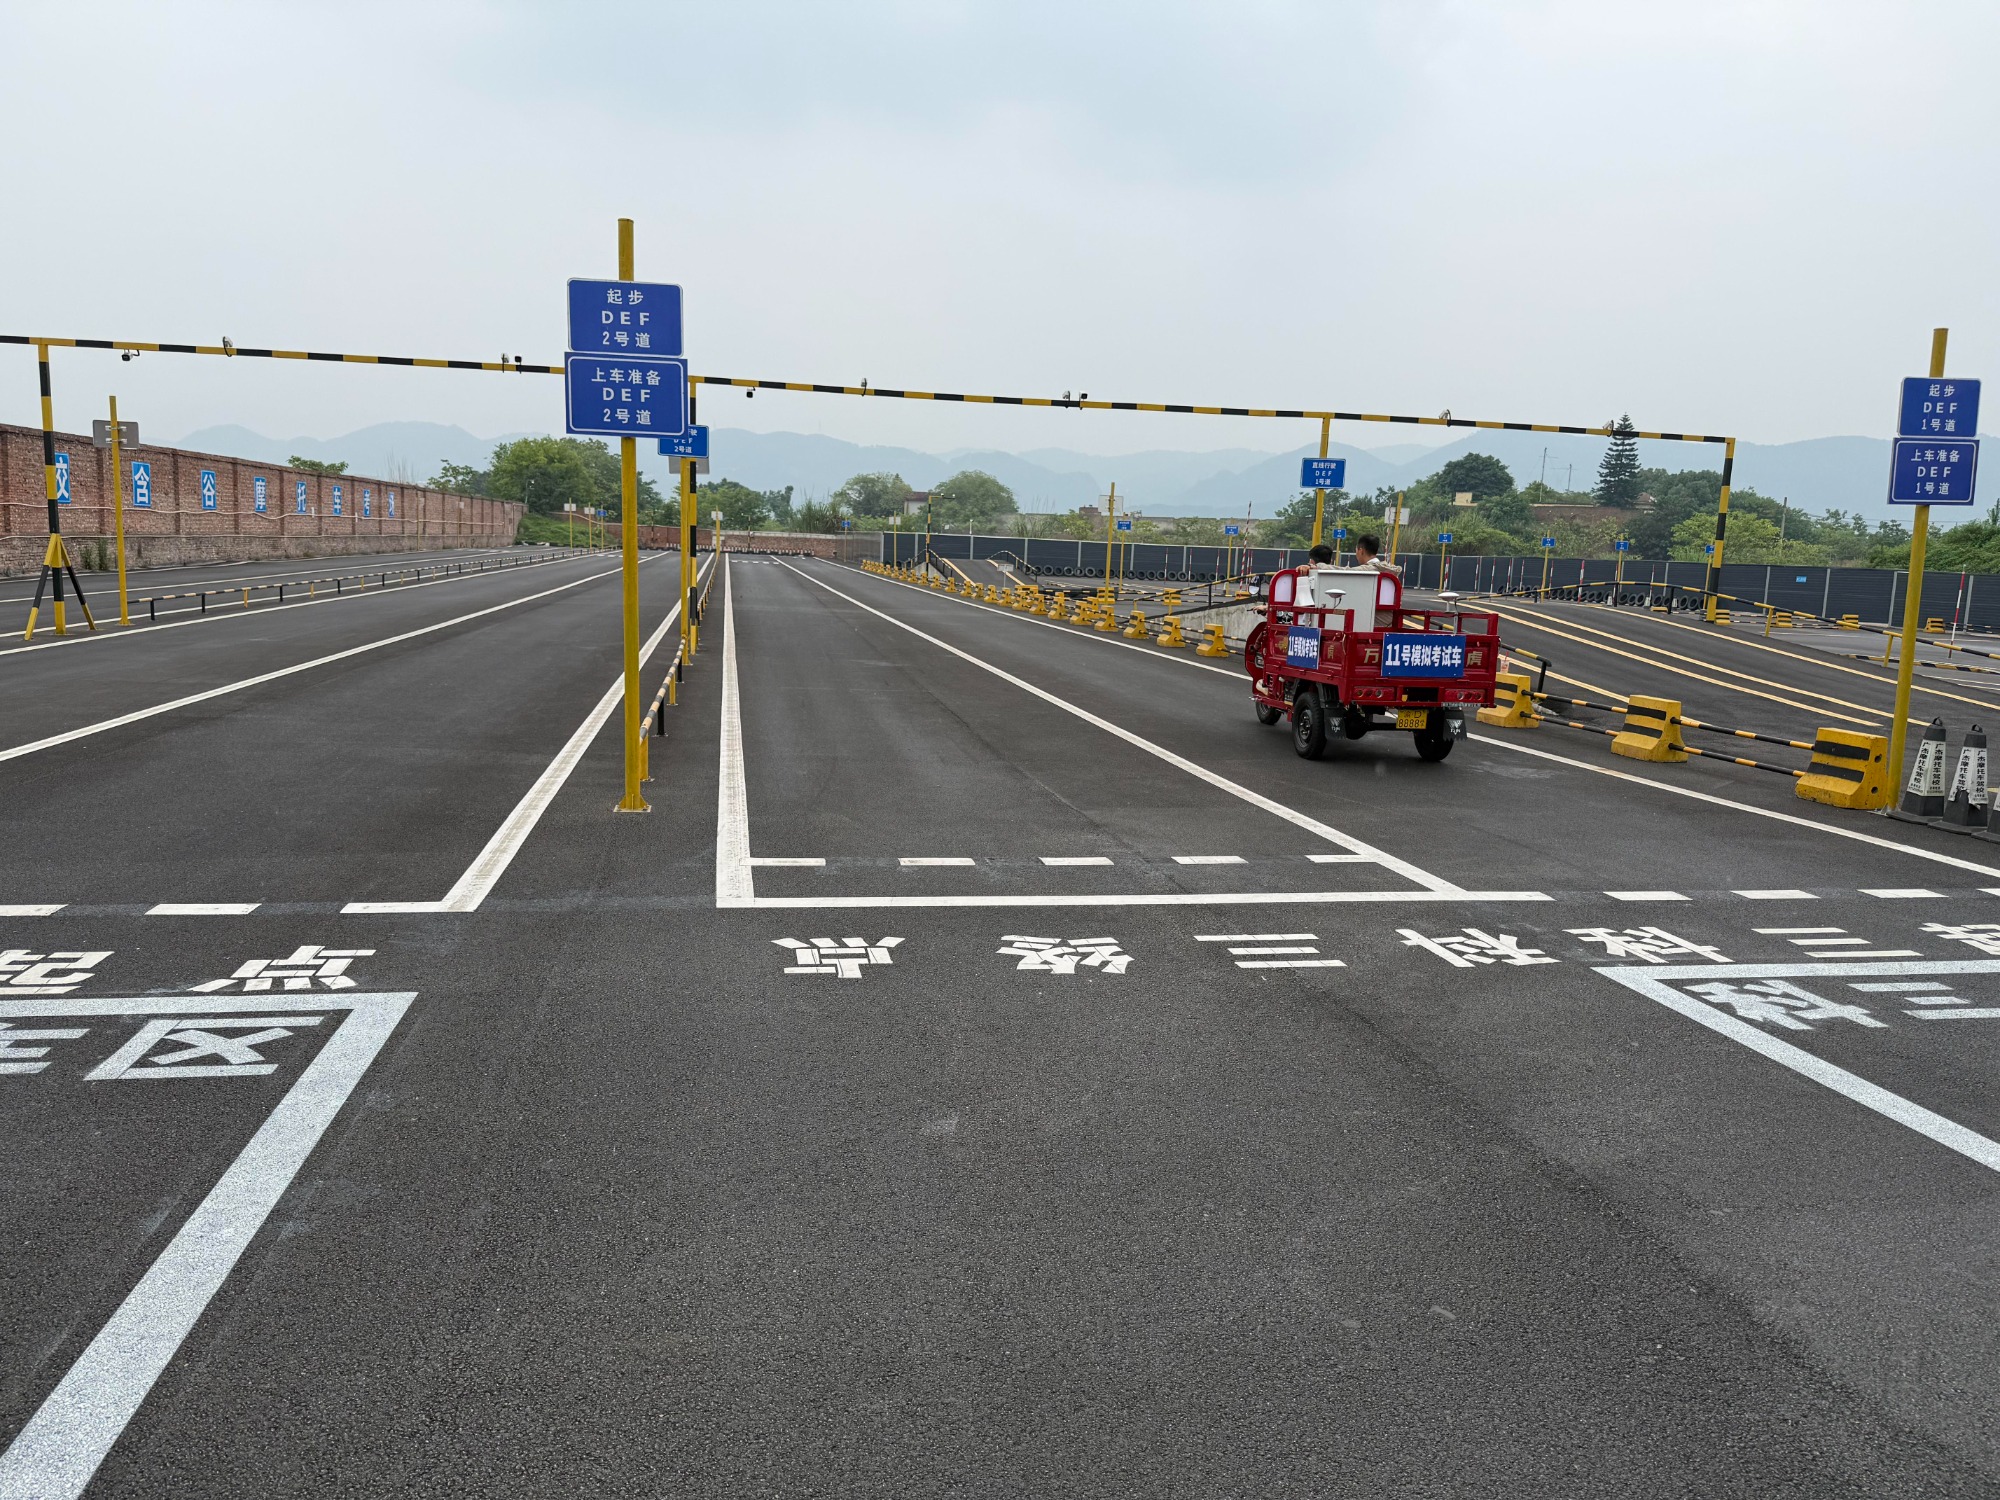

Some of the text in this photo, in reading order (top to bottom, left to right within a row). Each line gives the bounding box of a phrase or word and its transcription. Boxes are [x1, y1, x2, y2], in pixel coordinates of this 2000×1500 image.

[607, 288, 643, 305] 起步
[602, 331, 651, 348] 2号道
[591, 367, 661, 386] 上车准备
[1929, 384, 1955, 397] 起步
[603, 408, 651, 425] 2号道
[1921, 419, 1956, 432] 1号道
[1911, 449, 1960, 462] 上车准备
[1915, 482, 1950, 495] 1号道
[1364, 648, 1379, 664] 万
[1385, 643, 1462, 668] 11号模拟考试车
[1466, 651, 1482, 666] 虎
[1913, 742, 1930, 784] 广杰摩托车驾校
[1931, 743, 1944, 785] 广杰摩托车驾校
[1976, 749, 1986, 793] 广杰摩托车驾校
